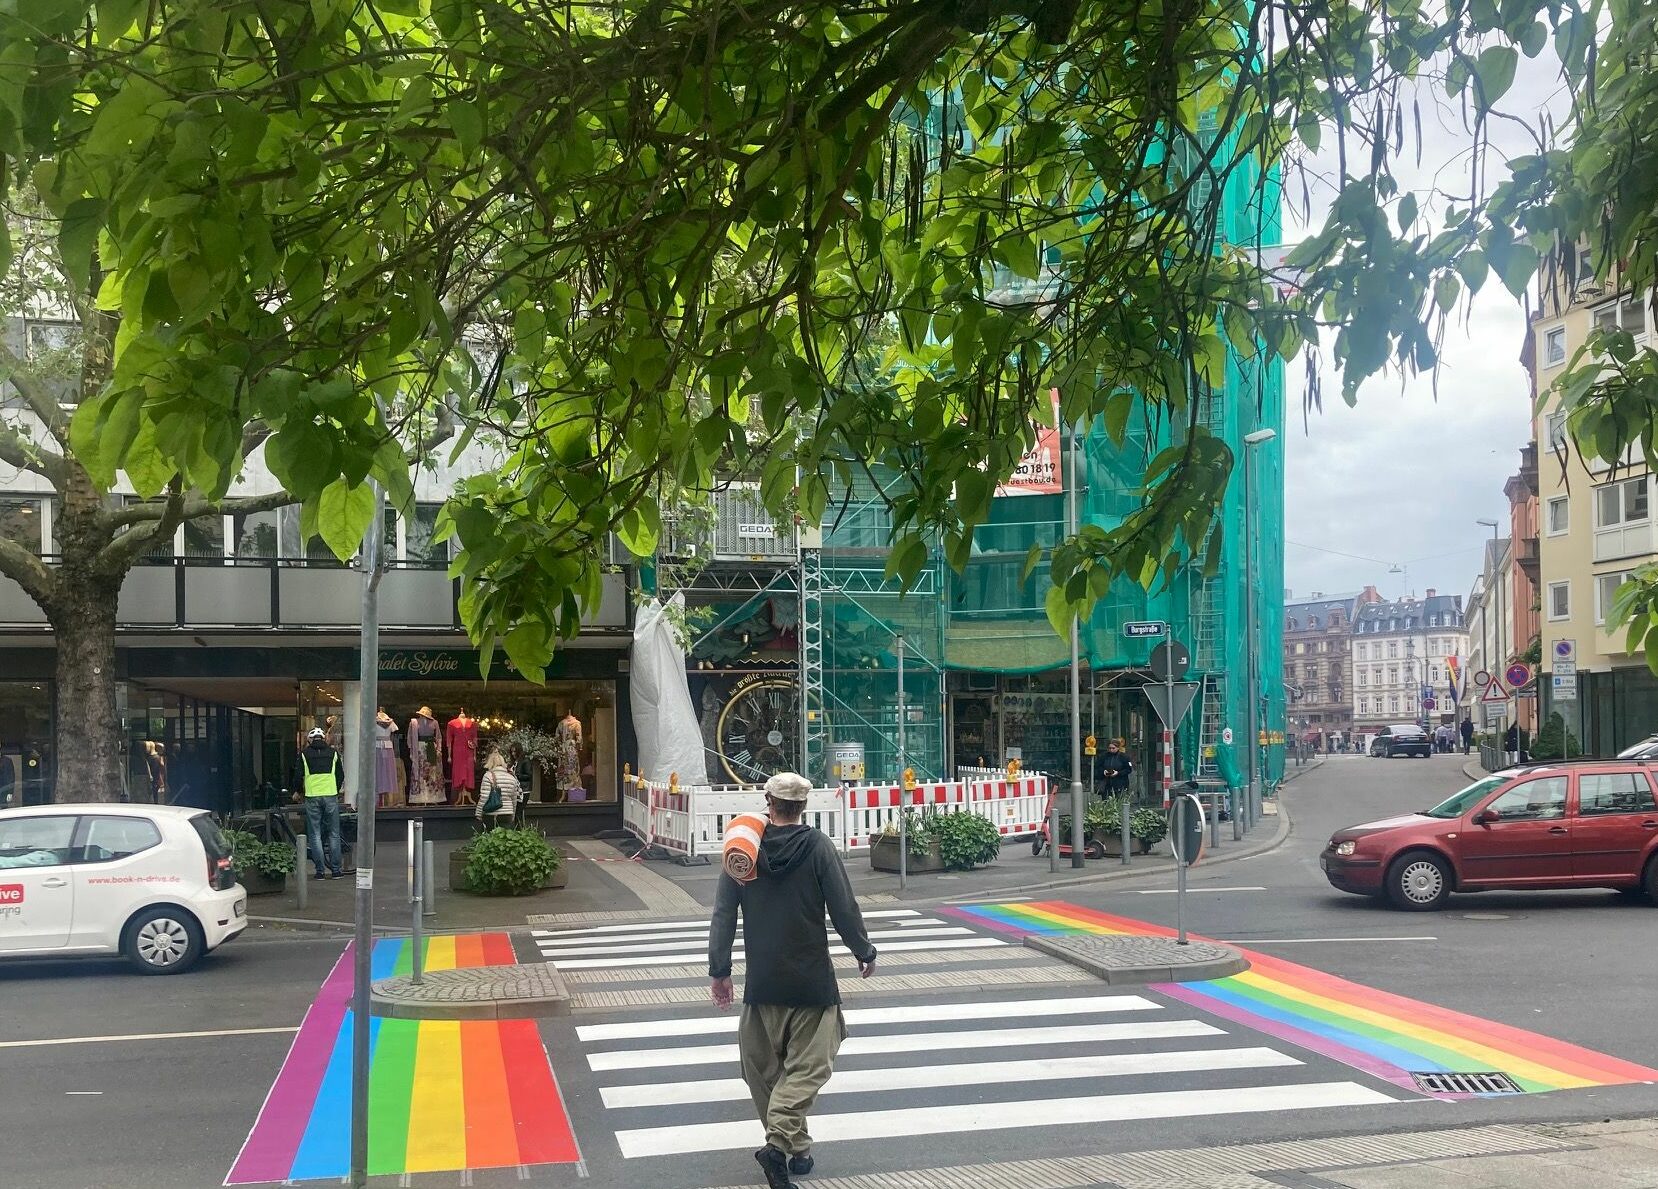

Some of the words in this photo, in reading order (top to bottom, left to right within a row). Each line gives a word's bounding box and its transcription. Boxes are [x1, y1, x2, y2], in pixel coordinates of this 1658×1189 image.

[1031, 464, 1042, 473] 18
[1045, 463, 1056, 472] 19
[378, 651, 406, 671] halet
[408, 651, 459, 675] Sylvie
[88, 875, 180, 884] www.book-n-drive.de
